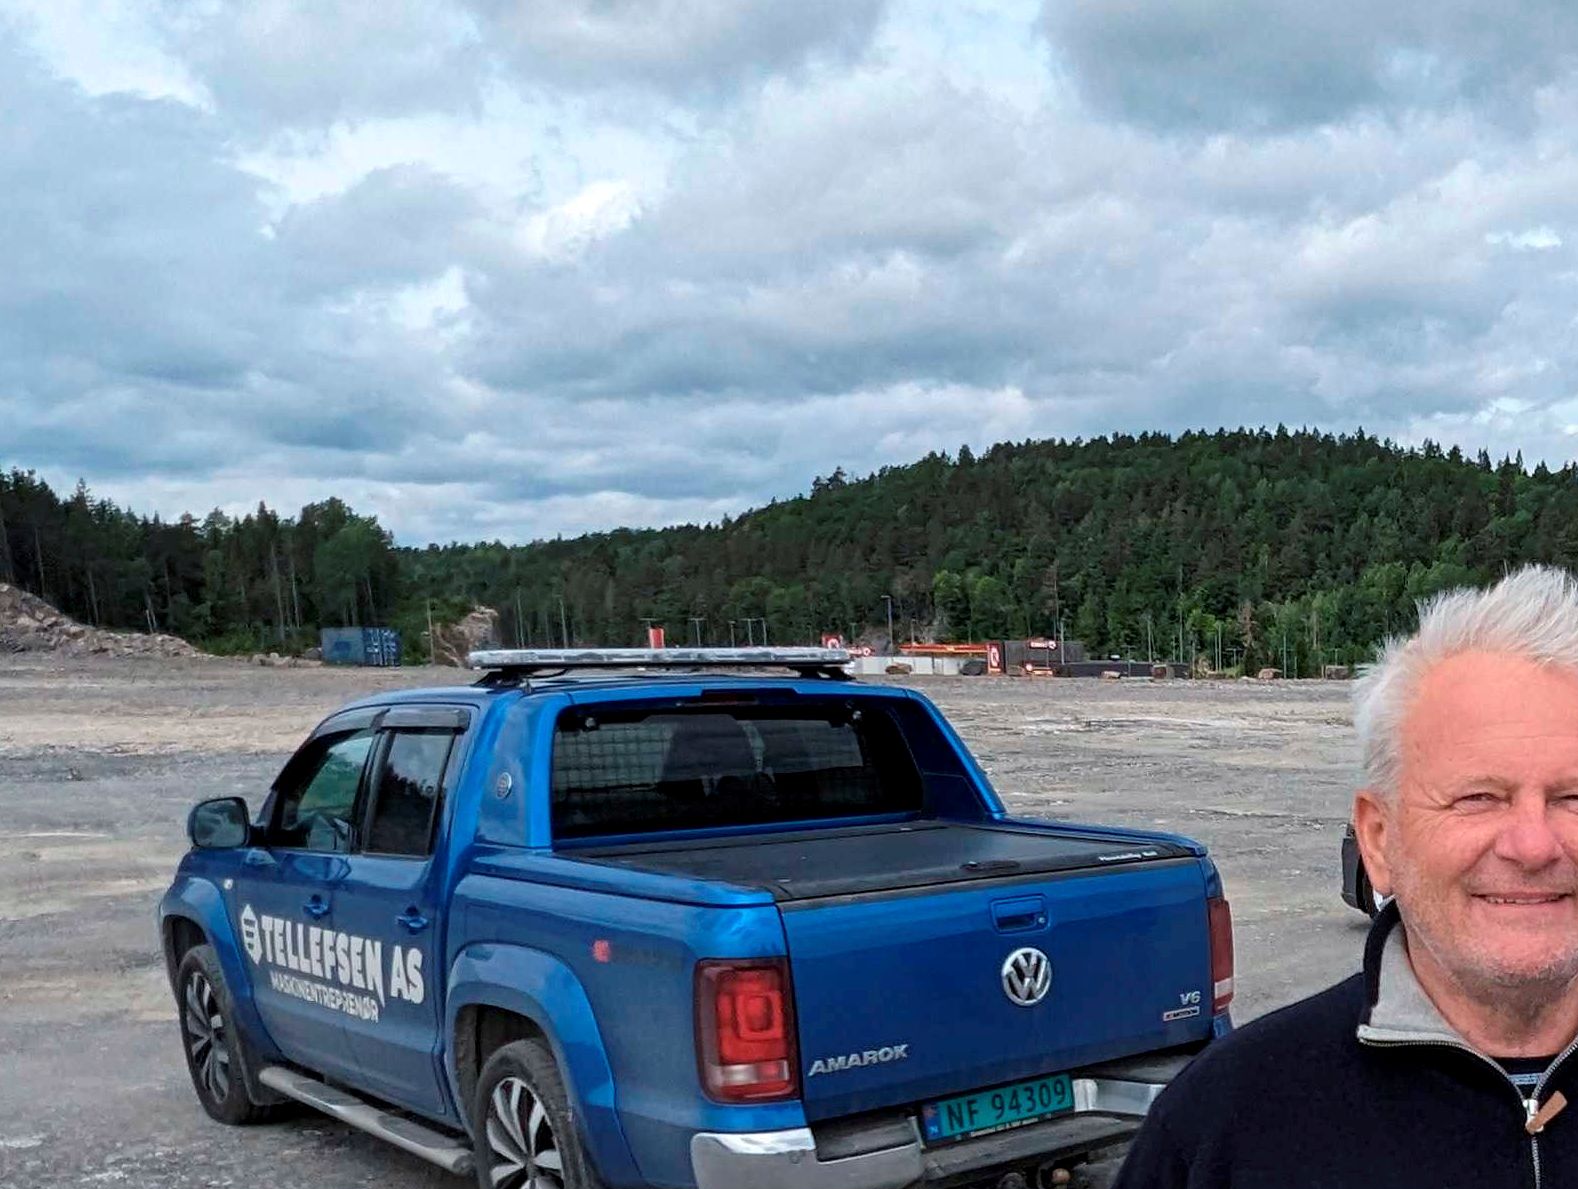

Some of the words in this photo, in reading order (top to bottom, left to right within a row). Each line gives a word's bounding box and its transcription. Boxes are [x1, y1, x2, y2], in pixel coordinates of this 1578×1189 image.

[260, 914, 386, 1009] TELLEFSEN
[390, 944, 425, 1004] AS
[1179, 990, 1201, 1006] V6
[807, 1043, 909, 1077] AMAROK
[946, 1099, 979, 1131] NF
[991, 1078, 1067, 1121] 94309
